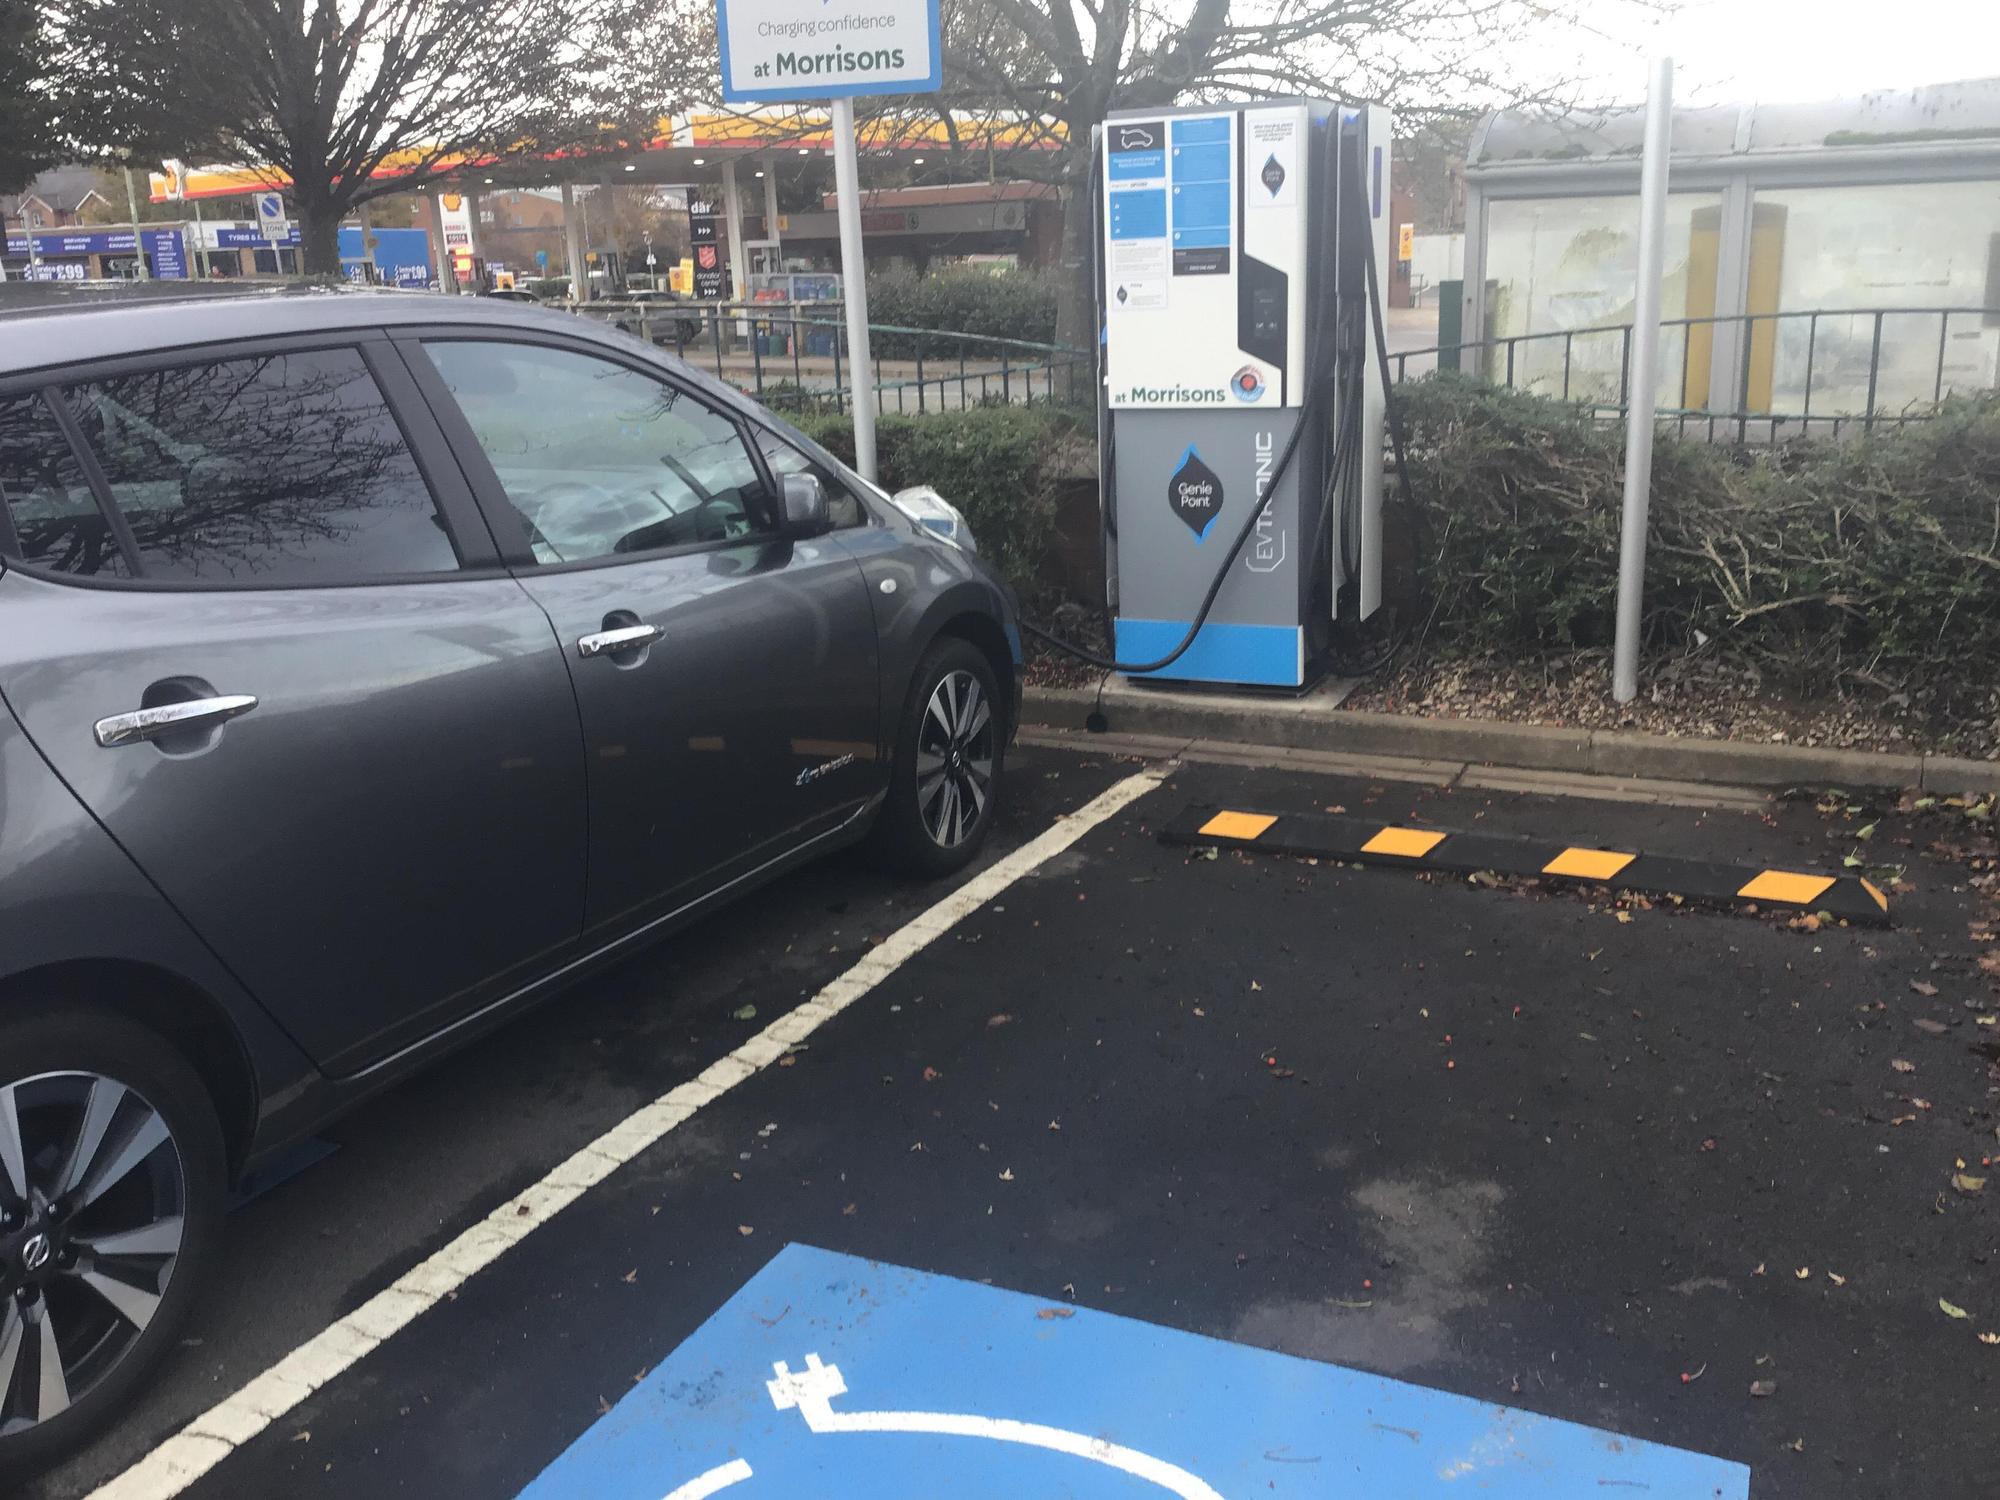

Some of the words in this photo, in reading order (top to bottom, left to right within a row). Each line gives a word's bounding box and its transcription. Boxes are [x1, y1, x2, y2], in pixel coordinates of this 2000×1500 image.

[758, 19, 816, 38] Charging
[818, 14, 895, 33] confidence
[754, 61, 770, 78] at
[776, 44, 904, 76] Morrisons
[1115, 393, 1126, 403] at
[1131, 384, 1226, 403] Morrisons
[1178, 480, 1213, 495] Genie
[1181, 495, 1211, 508] Point
